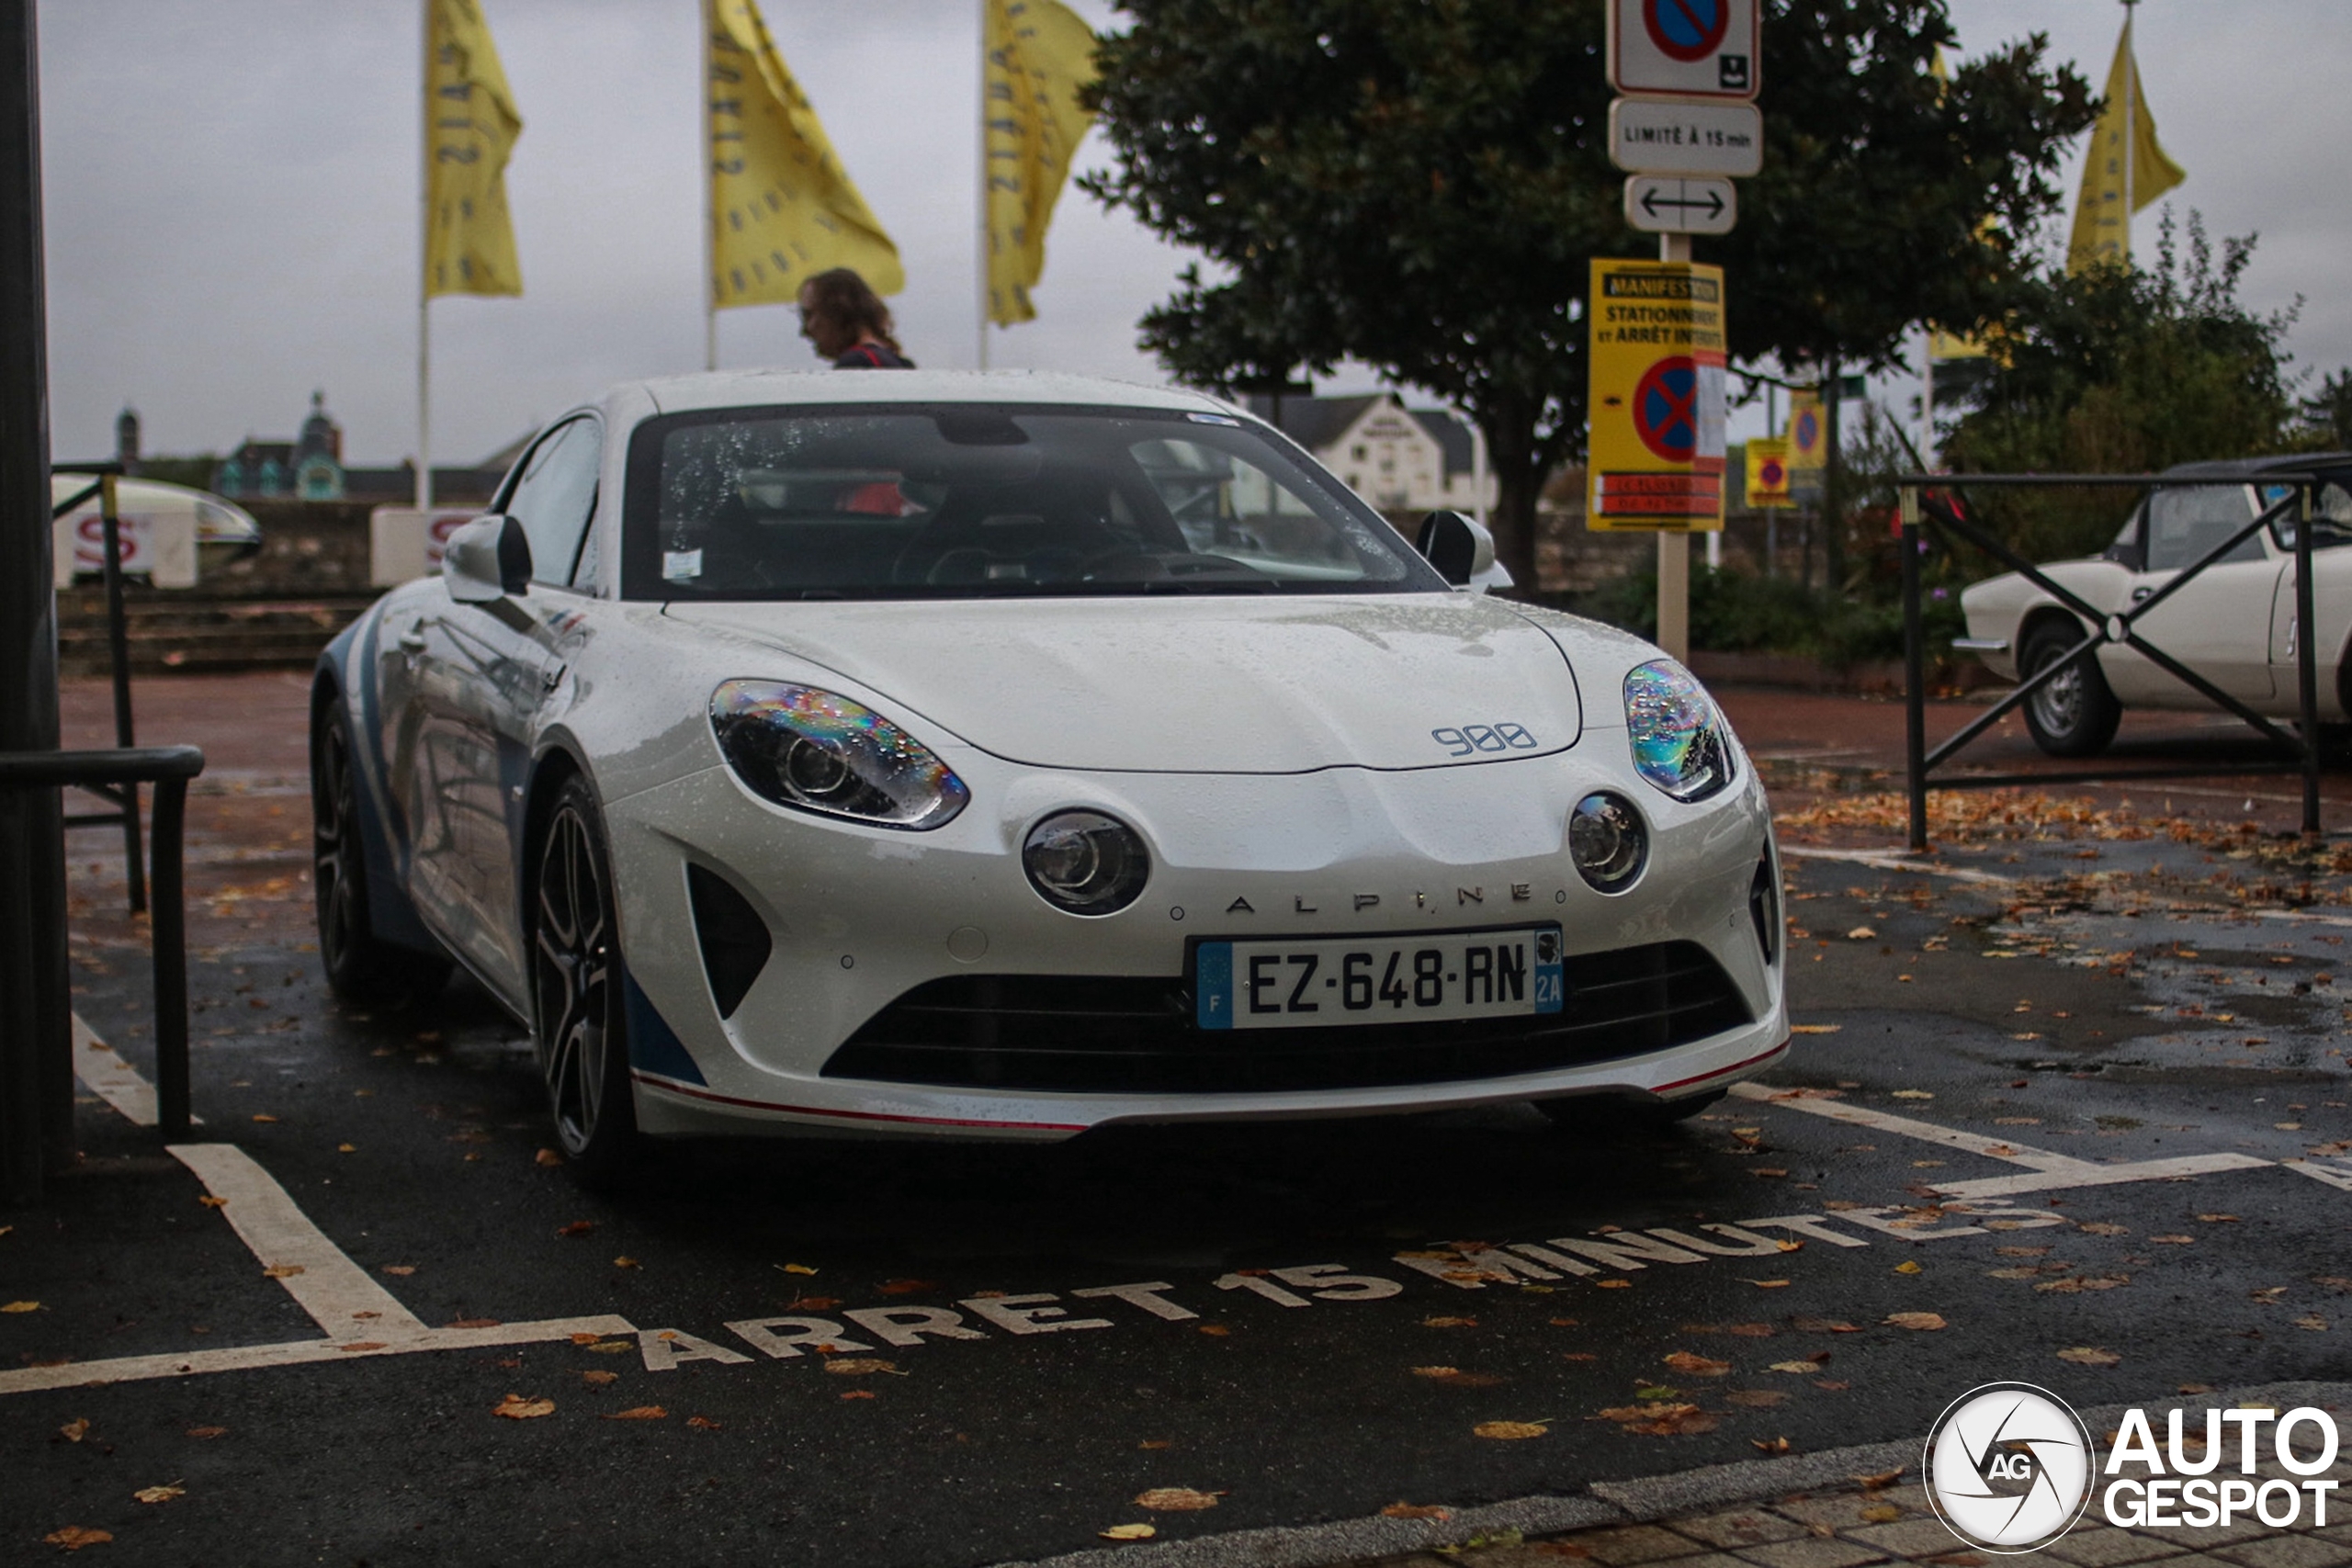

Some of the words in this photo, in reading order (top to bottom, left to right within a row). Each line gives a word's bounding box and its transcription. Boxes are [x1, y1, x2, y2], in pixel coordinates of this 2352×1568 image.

[1623, 126, 1682, 145] LIMITÉ
[1689, 126, 1700, 145] À
[1617, 325, 1671, 344] ARRÊT
[1431, 723, 1537, 757] 900
[1227, 883, 1531, 912] ALPINE
[1210, 995, 1220, 1012] F
[1536, 975, 1561, 1003] 2A
[639, 1280, 1200, 1371] ARRET
[1213, 1263, 1403, 1308] 15
[1390, 1199, 2066, 1289] MINUTES
